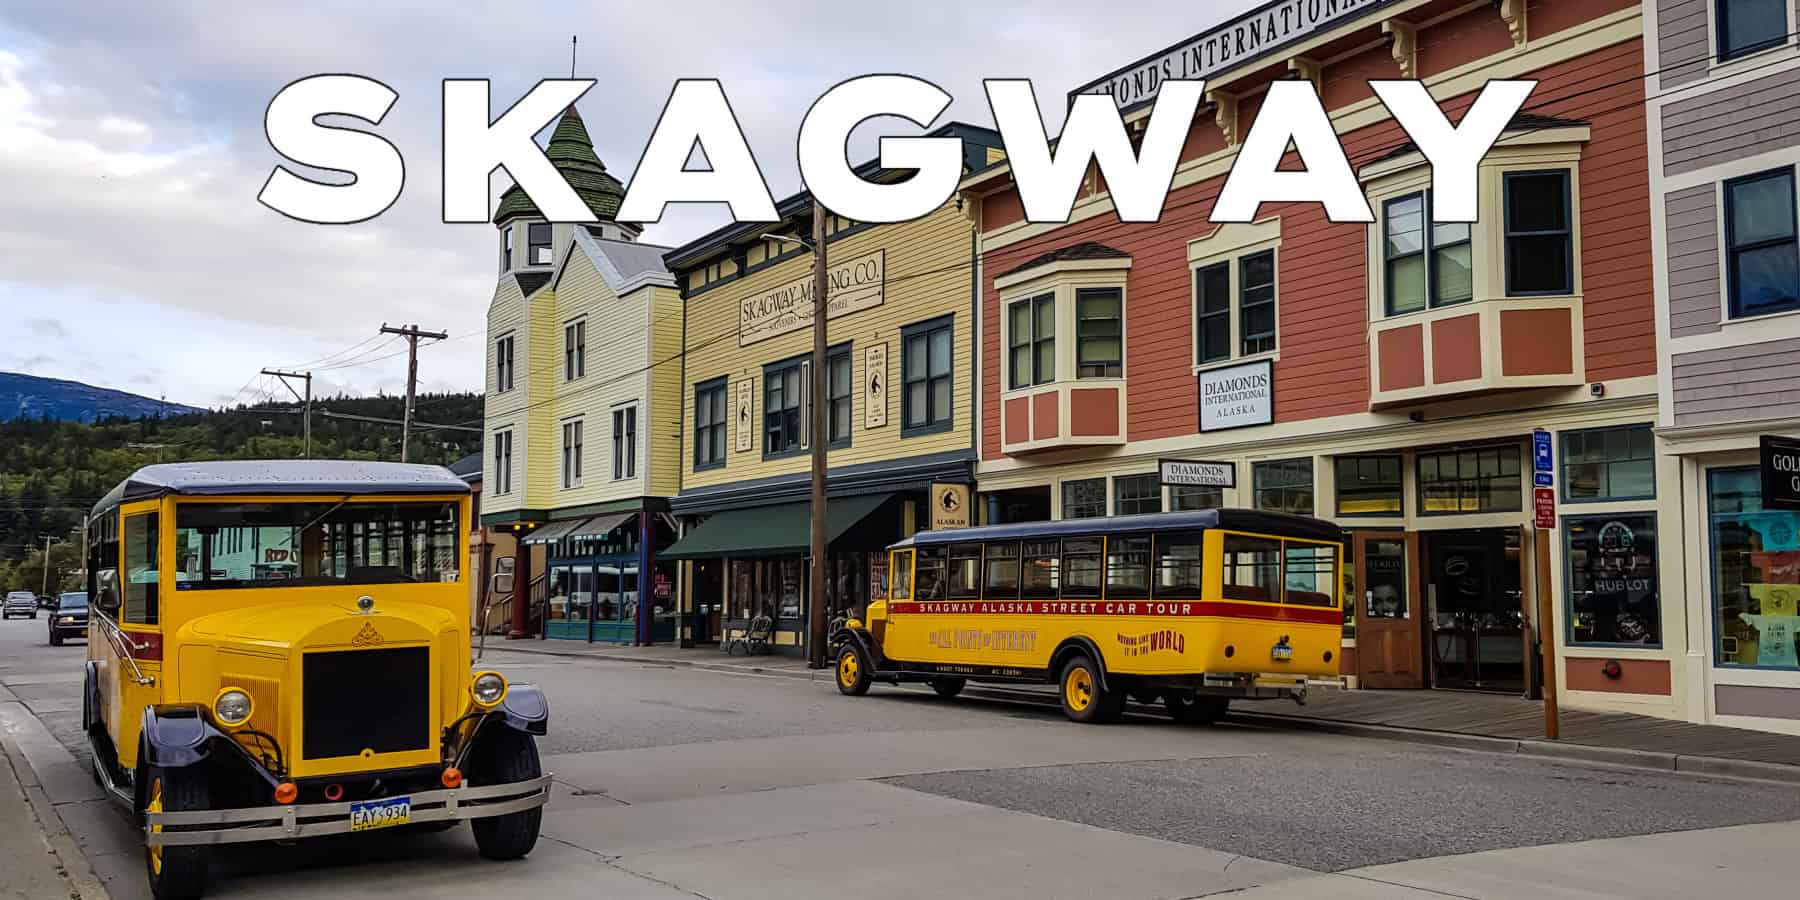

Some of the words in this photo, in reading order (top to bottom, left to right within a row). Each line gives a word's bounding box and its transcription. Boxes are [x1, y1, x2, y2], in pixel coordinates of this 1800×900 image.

[1181, 0, 1356, 78] INTERNATION
[742, 286, 799, 322] SKAGWAY
[800, 268, 850, 303] MING
[854, 259, 880, 285] CO.
[1205, 373, 1268, 396] DIAMONDS
[1205, 389, 1265, 406] INTERNATIONAL
[1216, 404, 1256, 418] ALASKA
[1171, 463, 1224, 475] DIAMONDS
[1773, 455, 1800, 472] GOL
[1167, 474, 1226, 485] INTERNATIONAL
[1595, 579, 1648, 592] HUBLOT
[919, 603, 975, 613] SKAGWAY
[981, 603, 1033, 613] ALASKA
[1042, 602, 1096, 613] STREET
[1105, 603, 1136, 614] CAR
[1146, 603, 1191, 615] TOUR
[1151, 630, 1184, 654] WORLD
[353, 809, 377, 826] EAY
[385, 804, 407, 822] 934
